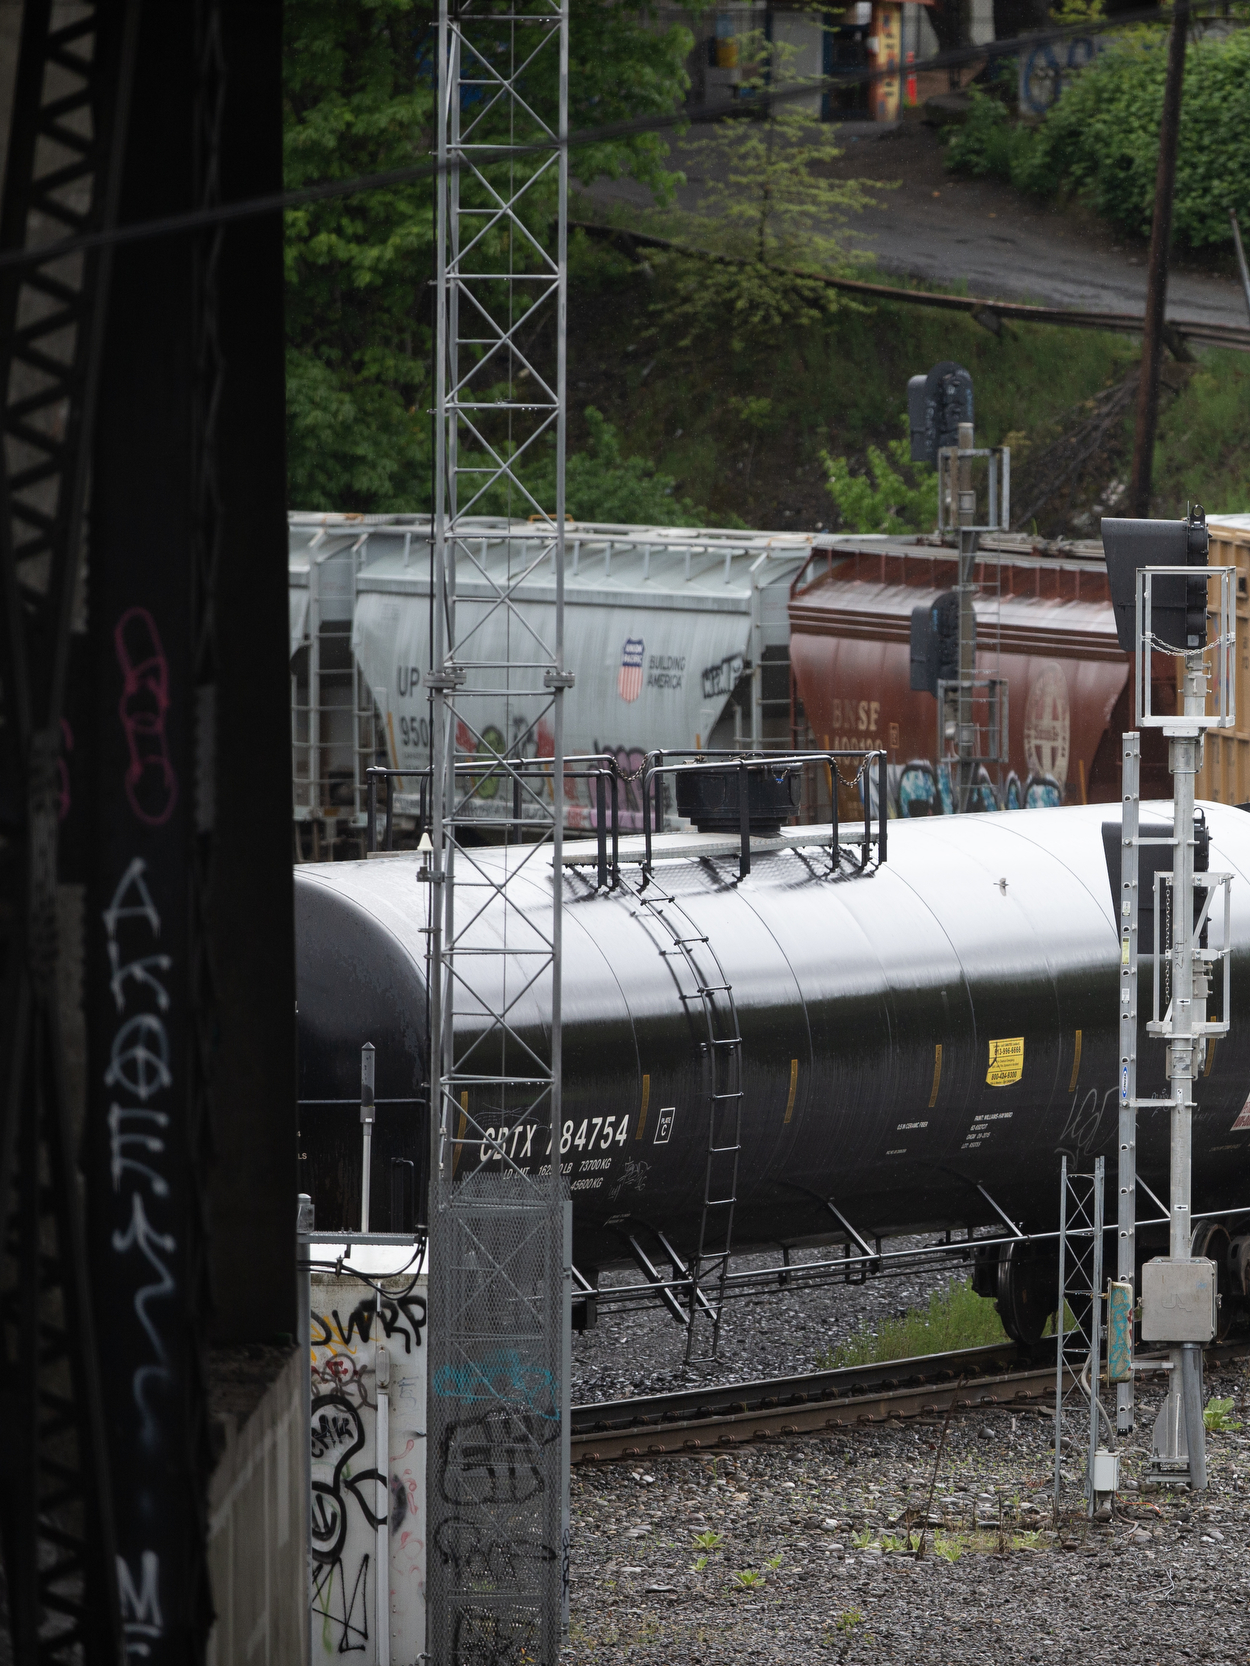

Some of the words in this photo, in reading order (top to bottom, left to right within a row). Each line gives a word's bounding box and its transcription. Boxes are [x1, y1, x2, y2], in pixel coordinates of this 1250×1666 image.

[649, 655, 686, 671] BUILDING
[397, 666, 420, 698] UP
[647, 673, 682, 689] AMERICA
[832, 698, 880, 732] BNSF
[661, 1124, 667, 1136] C
[480, 1124, 537, 1162] CBTX
[563, 1162, 574, 1174] LB
[579, 1160, 602, 1172] 73700
[601, 1158, 612, 1170] KG
[570, 1180, 595, 1191] 45600
[592, 1178, 603, 1188] KG
